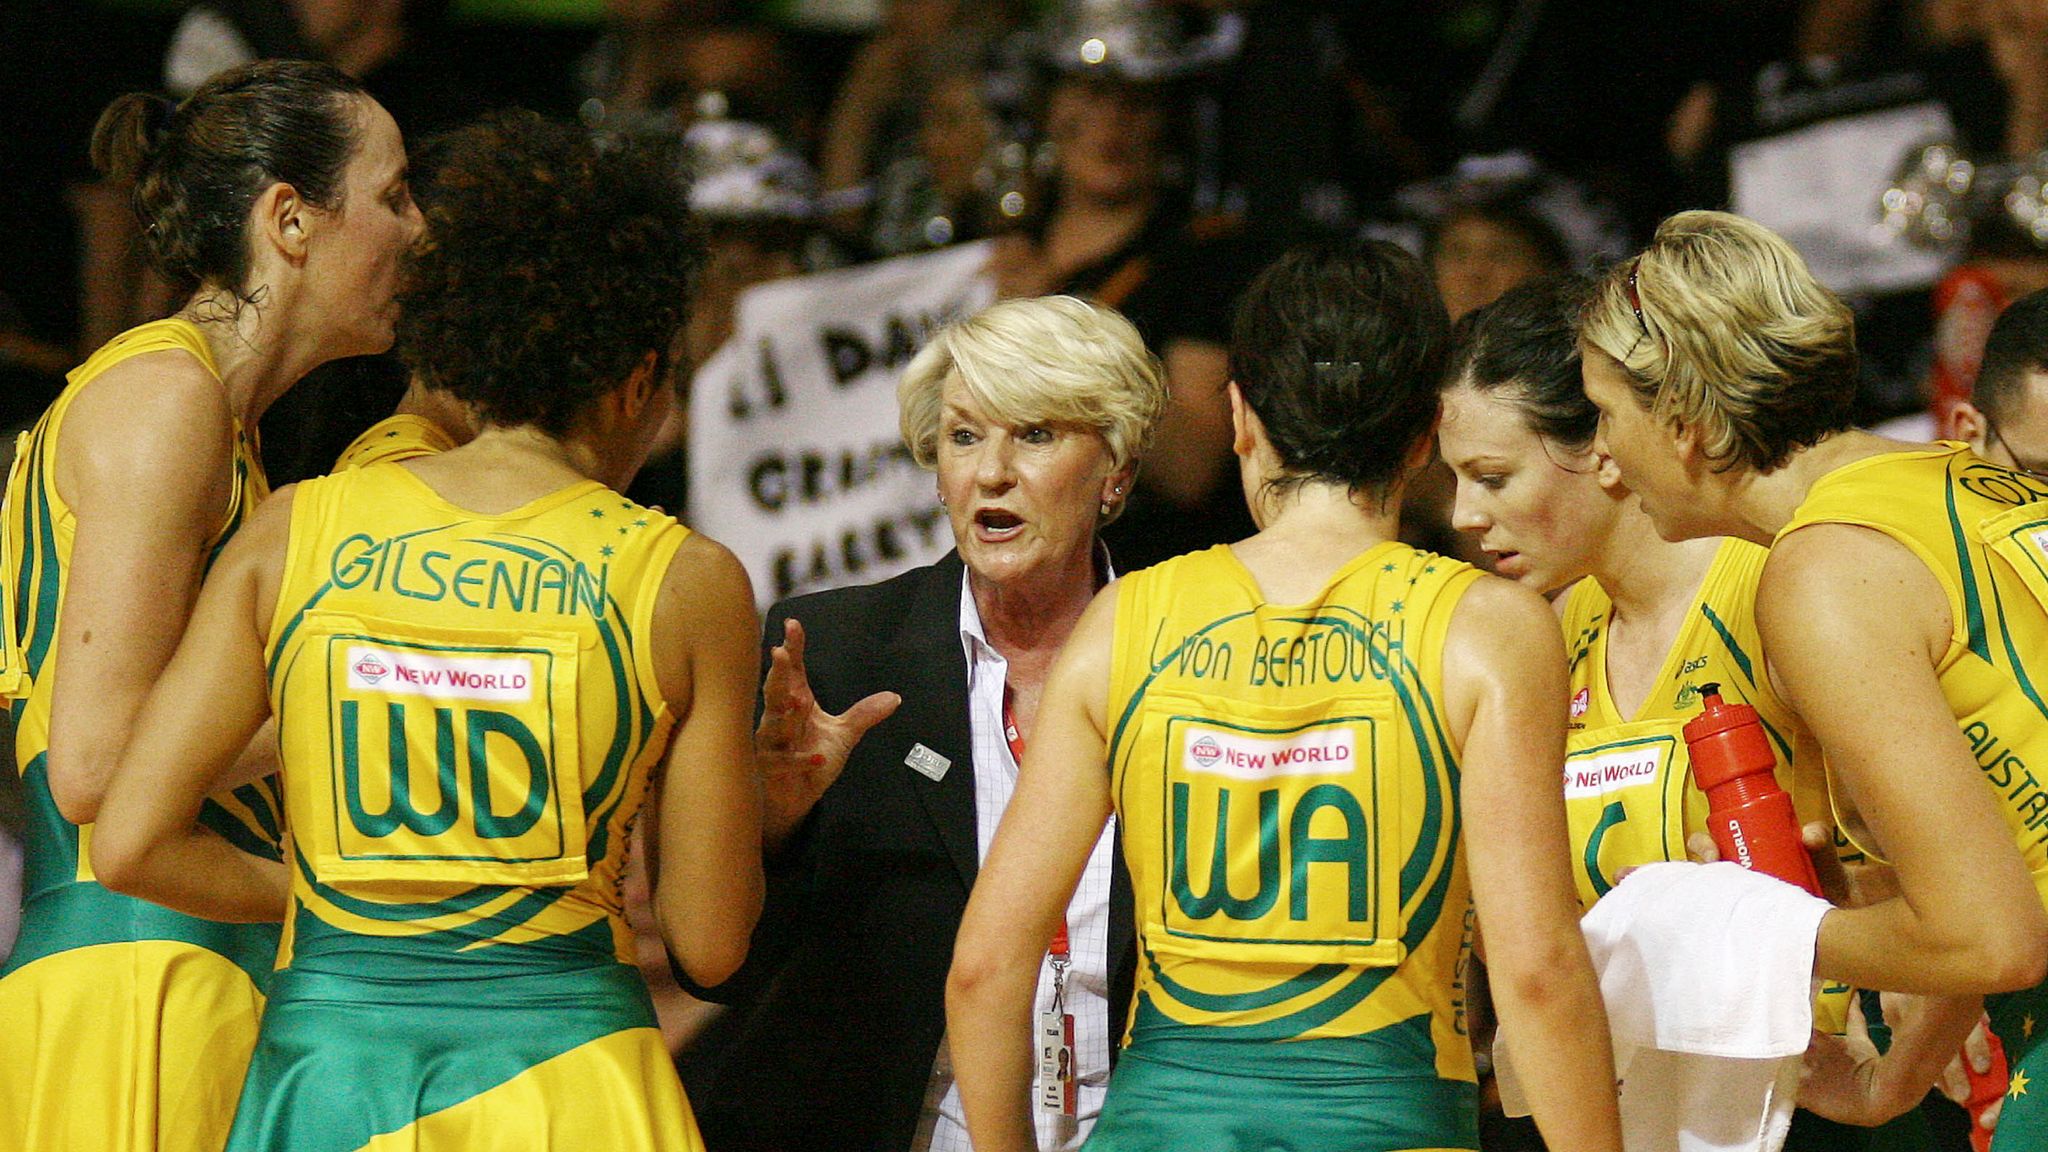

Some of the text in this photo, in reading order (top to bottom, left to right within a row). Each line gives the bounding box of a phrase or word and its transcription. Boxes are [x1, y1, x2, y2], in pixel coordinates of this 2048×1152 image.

[330, 533, 608, 620] GILSENAN
[395, 663, 526, 689] NEW WORLD
[1250, 619, 1404, 687] BERTOUCH
[340, 699, 550, 839] WD
[1226, 745, 1349, 769] NEW WORLD
[1171, 782, 1369, 922] WA
